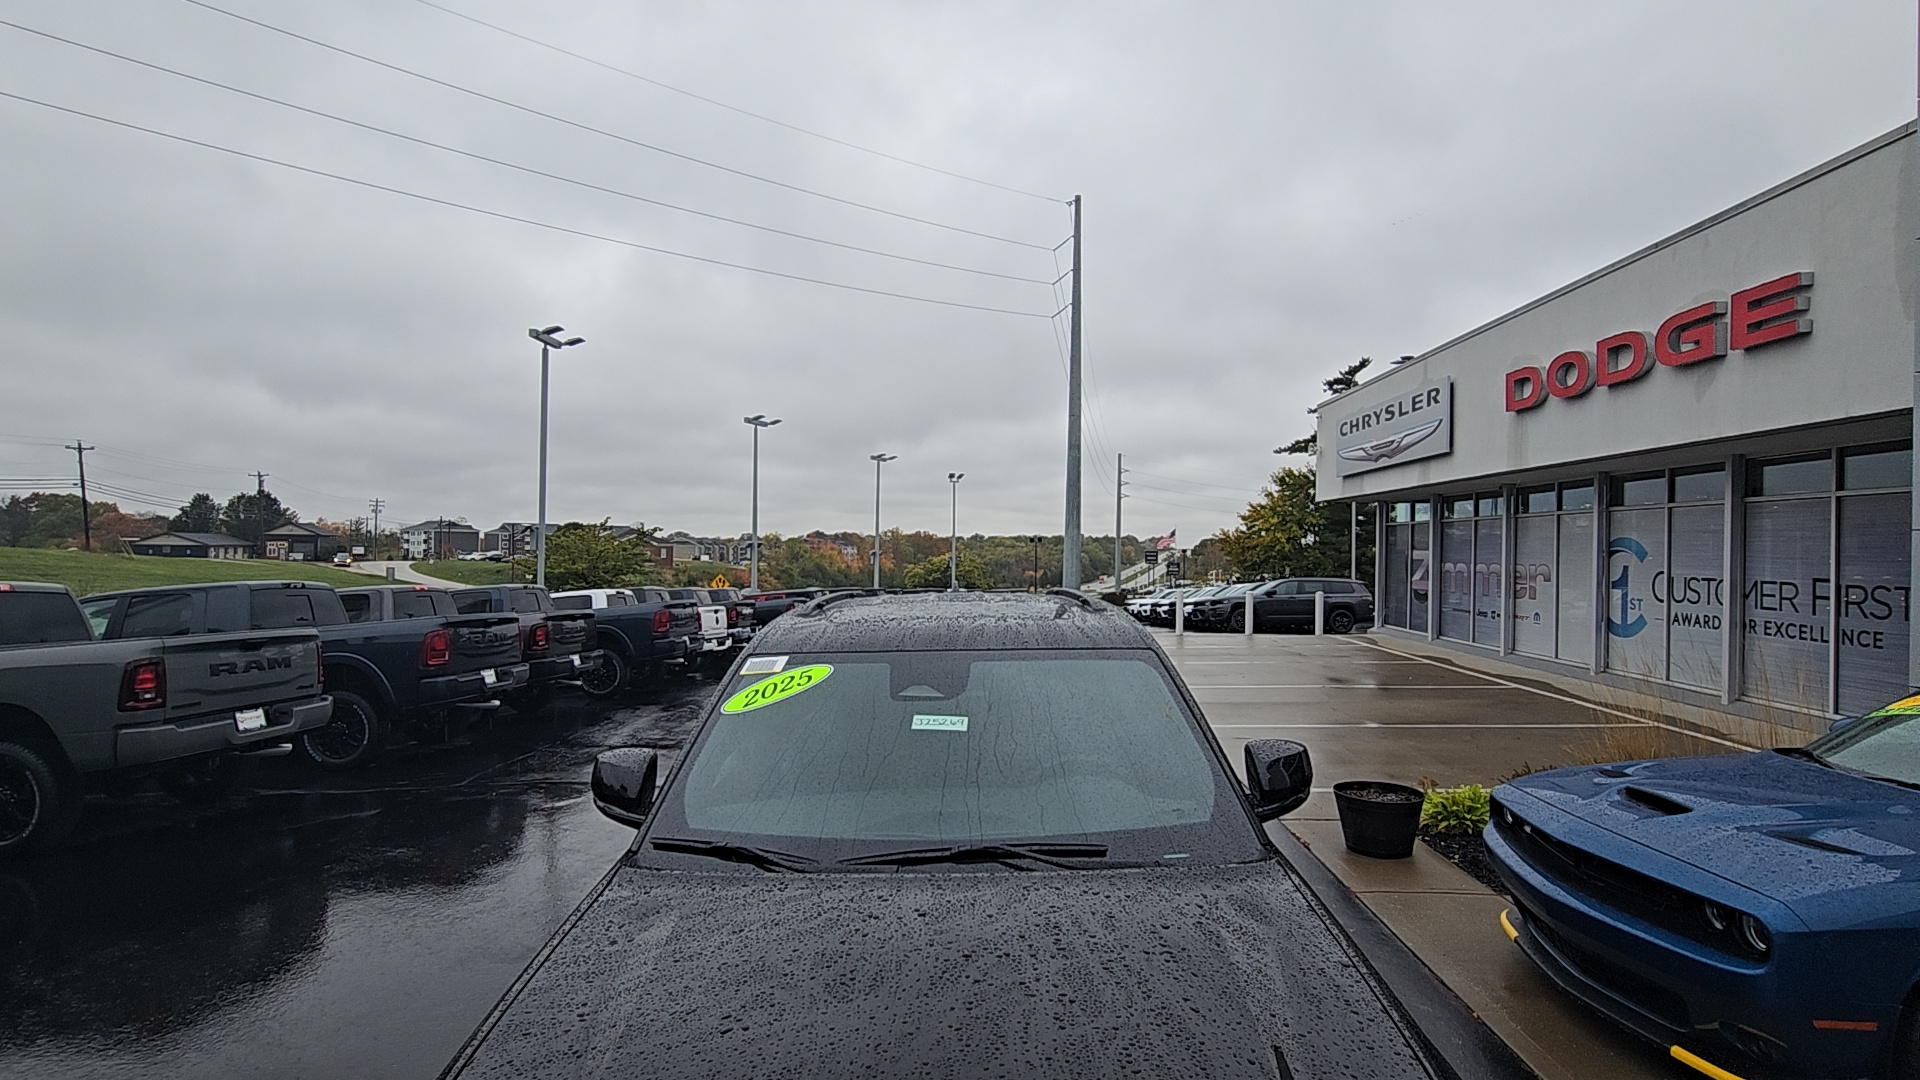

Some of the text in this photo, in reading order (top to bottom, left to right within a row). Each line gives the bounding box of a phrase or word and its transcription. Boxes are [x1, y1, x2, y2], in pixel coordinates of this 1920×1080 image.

[1505, 271, 1813, 412] DODGE
[1339, 387, 1441, 437] CHRYSLER
[1411, 550, 1552, 600] Zmmer
[1812, 577, 1911, 622] FIRST
[1671, 611, 1722, 630] AWARD
[1764, 619, 1884, 650] EXCELLNCE
[209, 655, 292, 677] RAM
[741, 667, 815, 709] 2025
